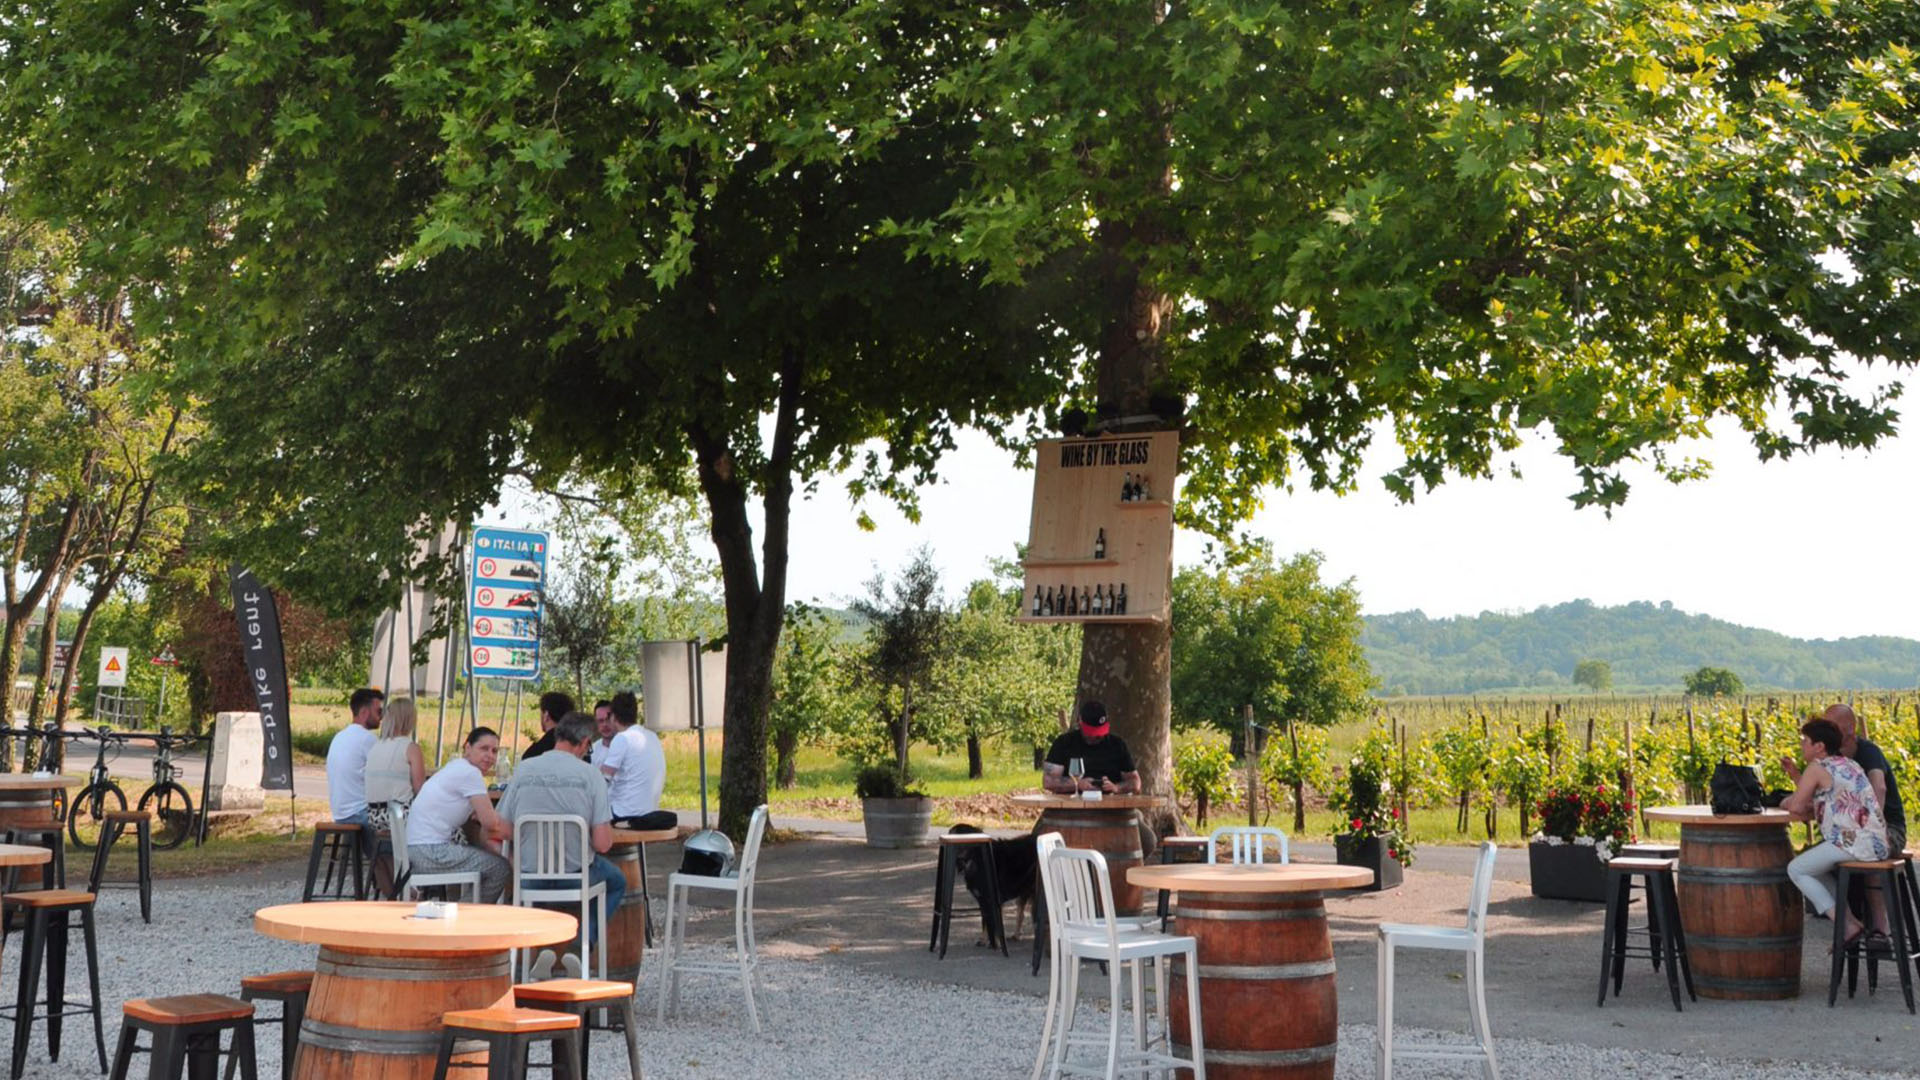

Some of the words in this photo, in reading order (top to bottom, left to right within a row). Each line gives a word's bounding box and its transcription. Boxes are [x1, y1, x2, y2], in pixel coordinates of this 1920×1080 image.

[1061, 444, 1085, 467] WINE
[1086, 443, 1100, 466] BY
[1101, 442, 1117, 465] THE
[1119, 441, 1149, 464] GLASS
[493, 538, 528, 552] ITALIA
